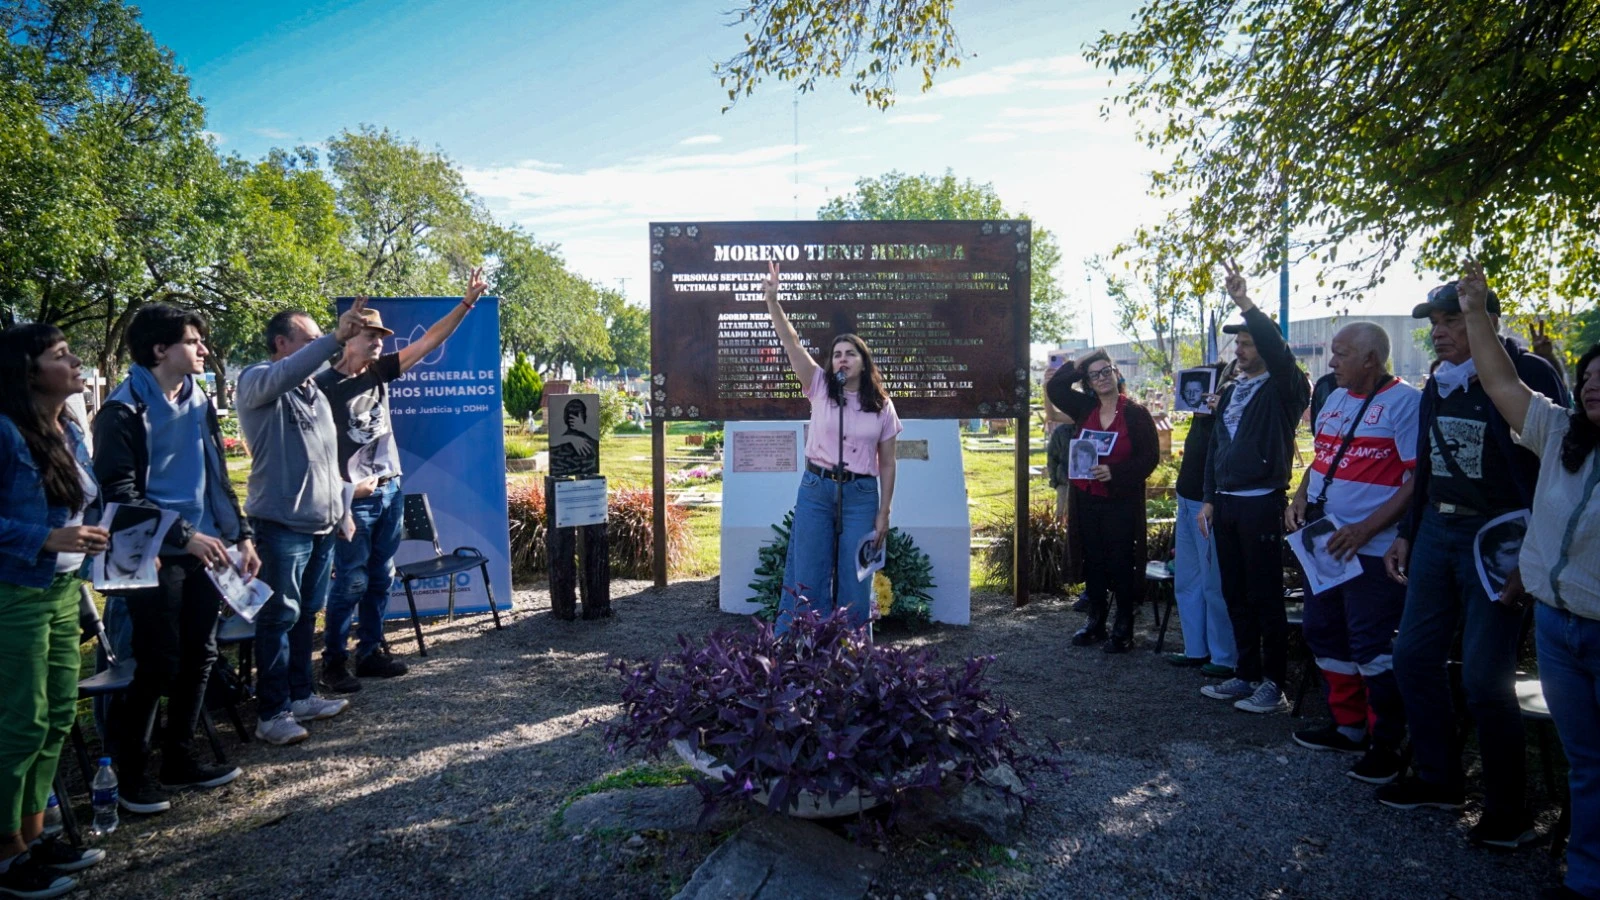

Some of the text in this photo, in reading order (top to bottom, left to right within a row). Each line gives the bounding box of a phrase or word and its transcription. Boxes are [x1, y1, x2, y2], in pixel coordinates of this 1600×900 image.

[713, 244, 965, 262] MORENO TIENE MEMORIA
[672, 272, 718, 281] PERSONAS
[720, 272, 771, 281] SEPULTADA
[779, 272, 804, 281] COMO
[674, 282, 718, 290] VICTIMAS
[718, 282, 730, 290] DE
[732, 282, 748, 290] LAS
[420, 370, 476, 380] GENERAL
[478, 370, 494, 380] DE
[425, 385, 495, 396] HUMANOS
[419, 404, 452, 414] Justicia
[455, 406, 461, 414] y
